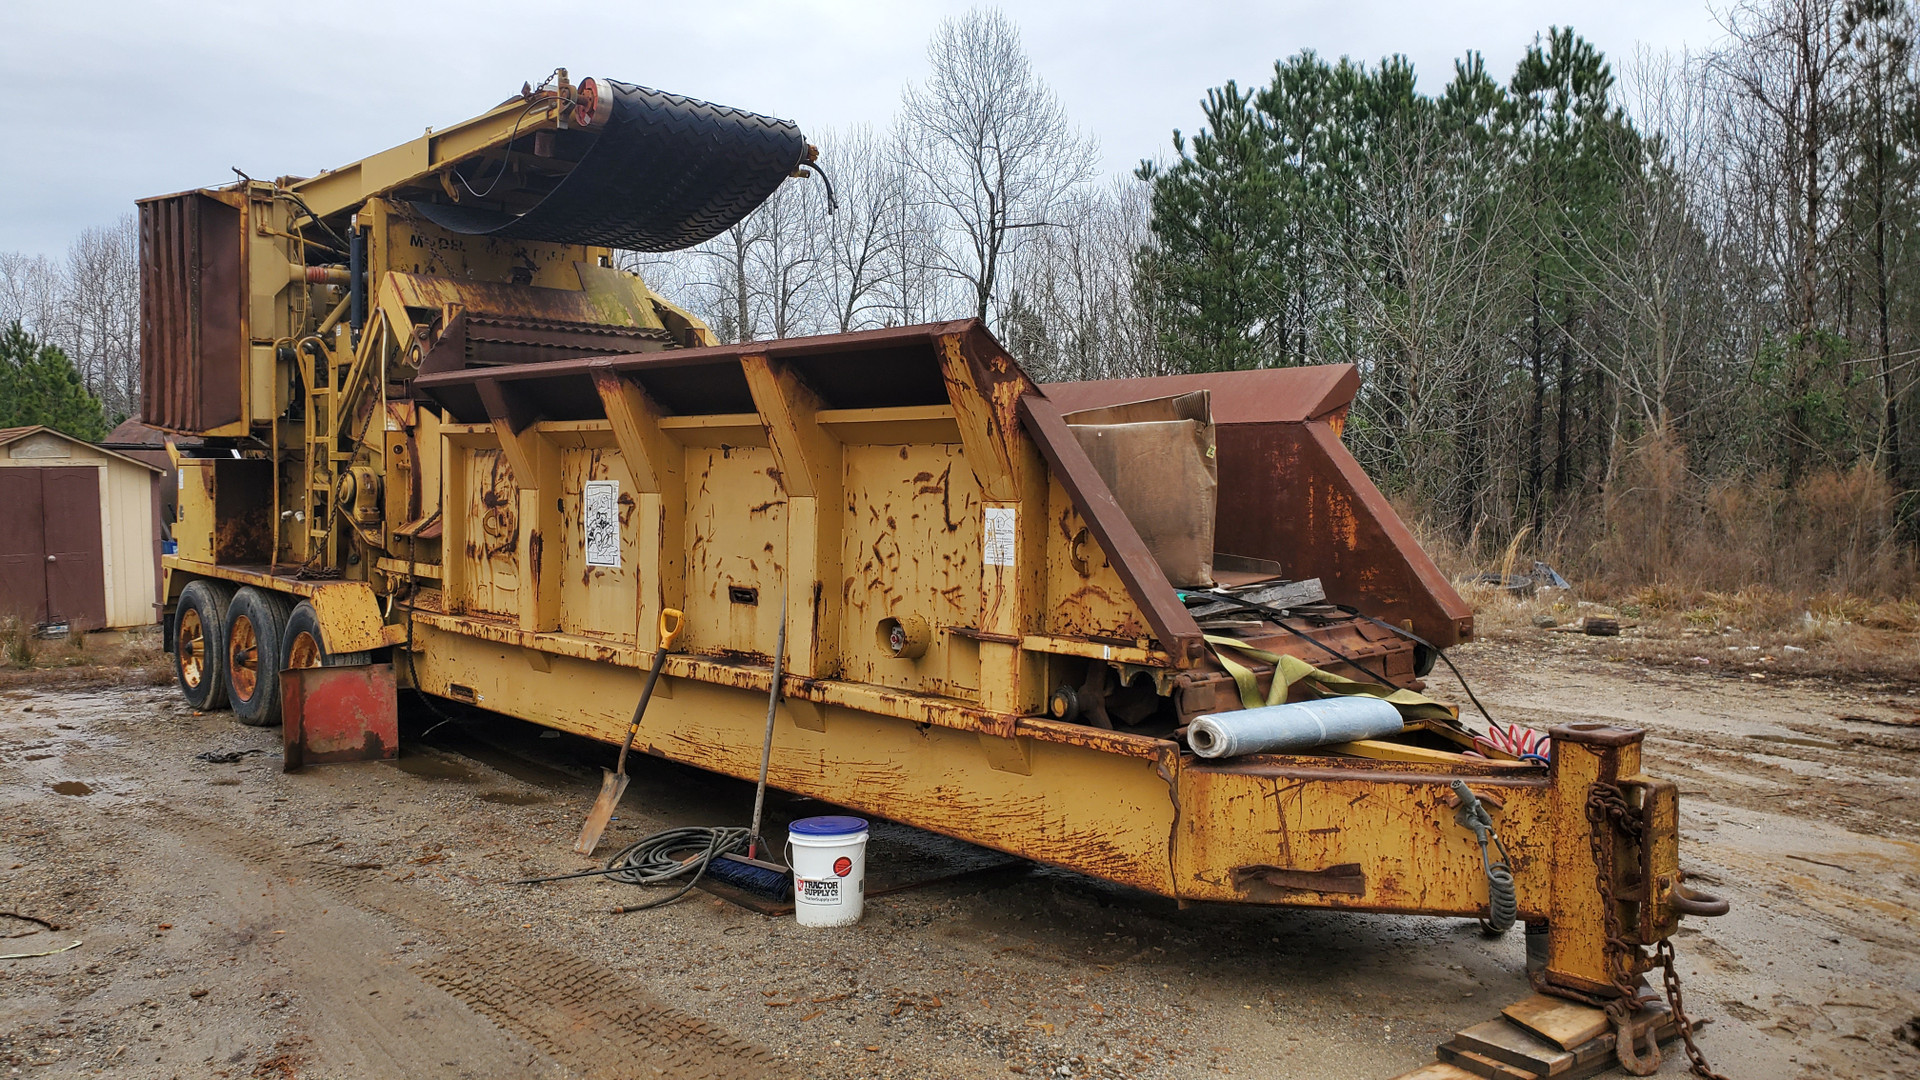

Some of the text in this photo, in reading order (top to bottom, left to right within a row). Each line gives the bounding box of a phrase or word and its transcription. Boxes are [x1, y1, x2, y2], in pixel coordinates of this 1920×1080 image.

[410, 235, 466, 252] MDEL
[804, 880, 838, 889] TRACTOR
[804, 888, 830, 896] SUPPLY
